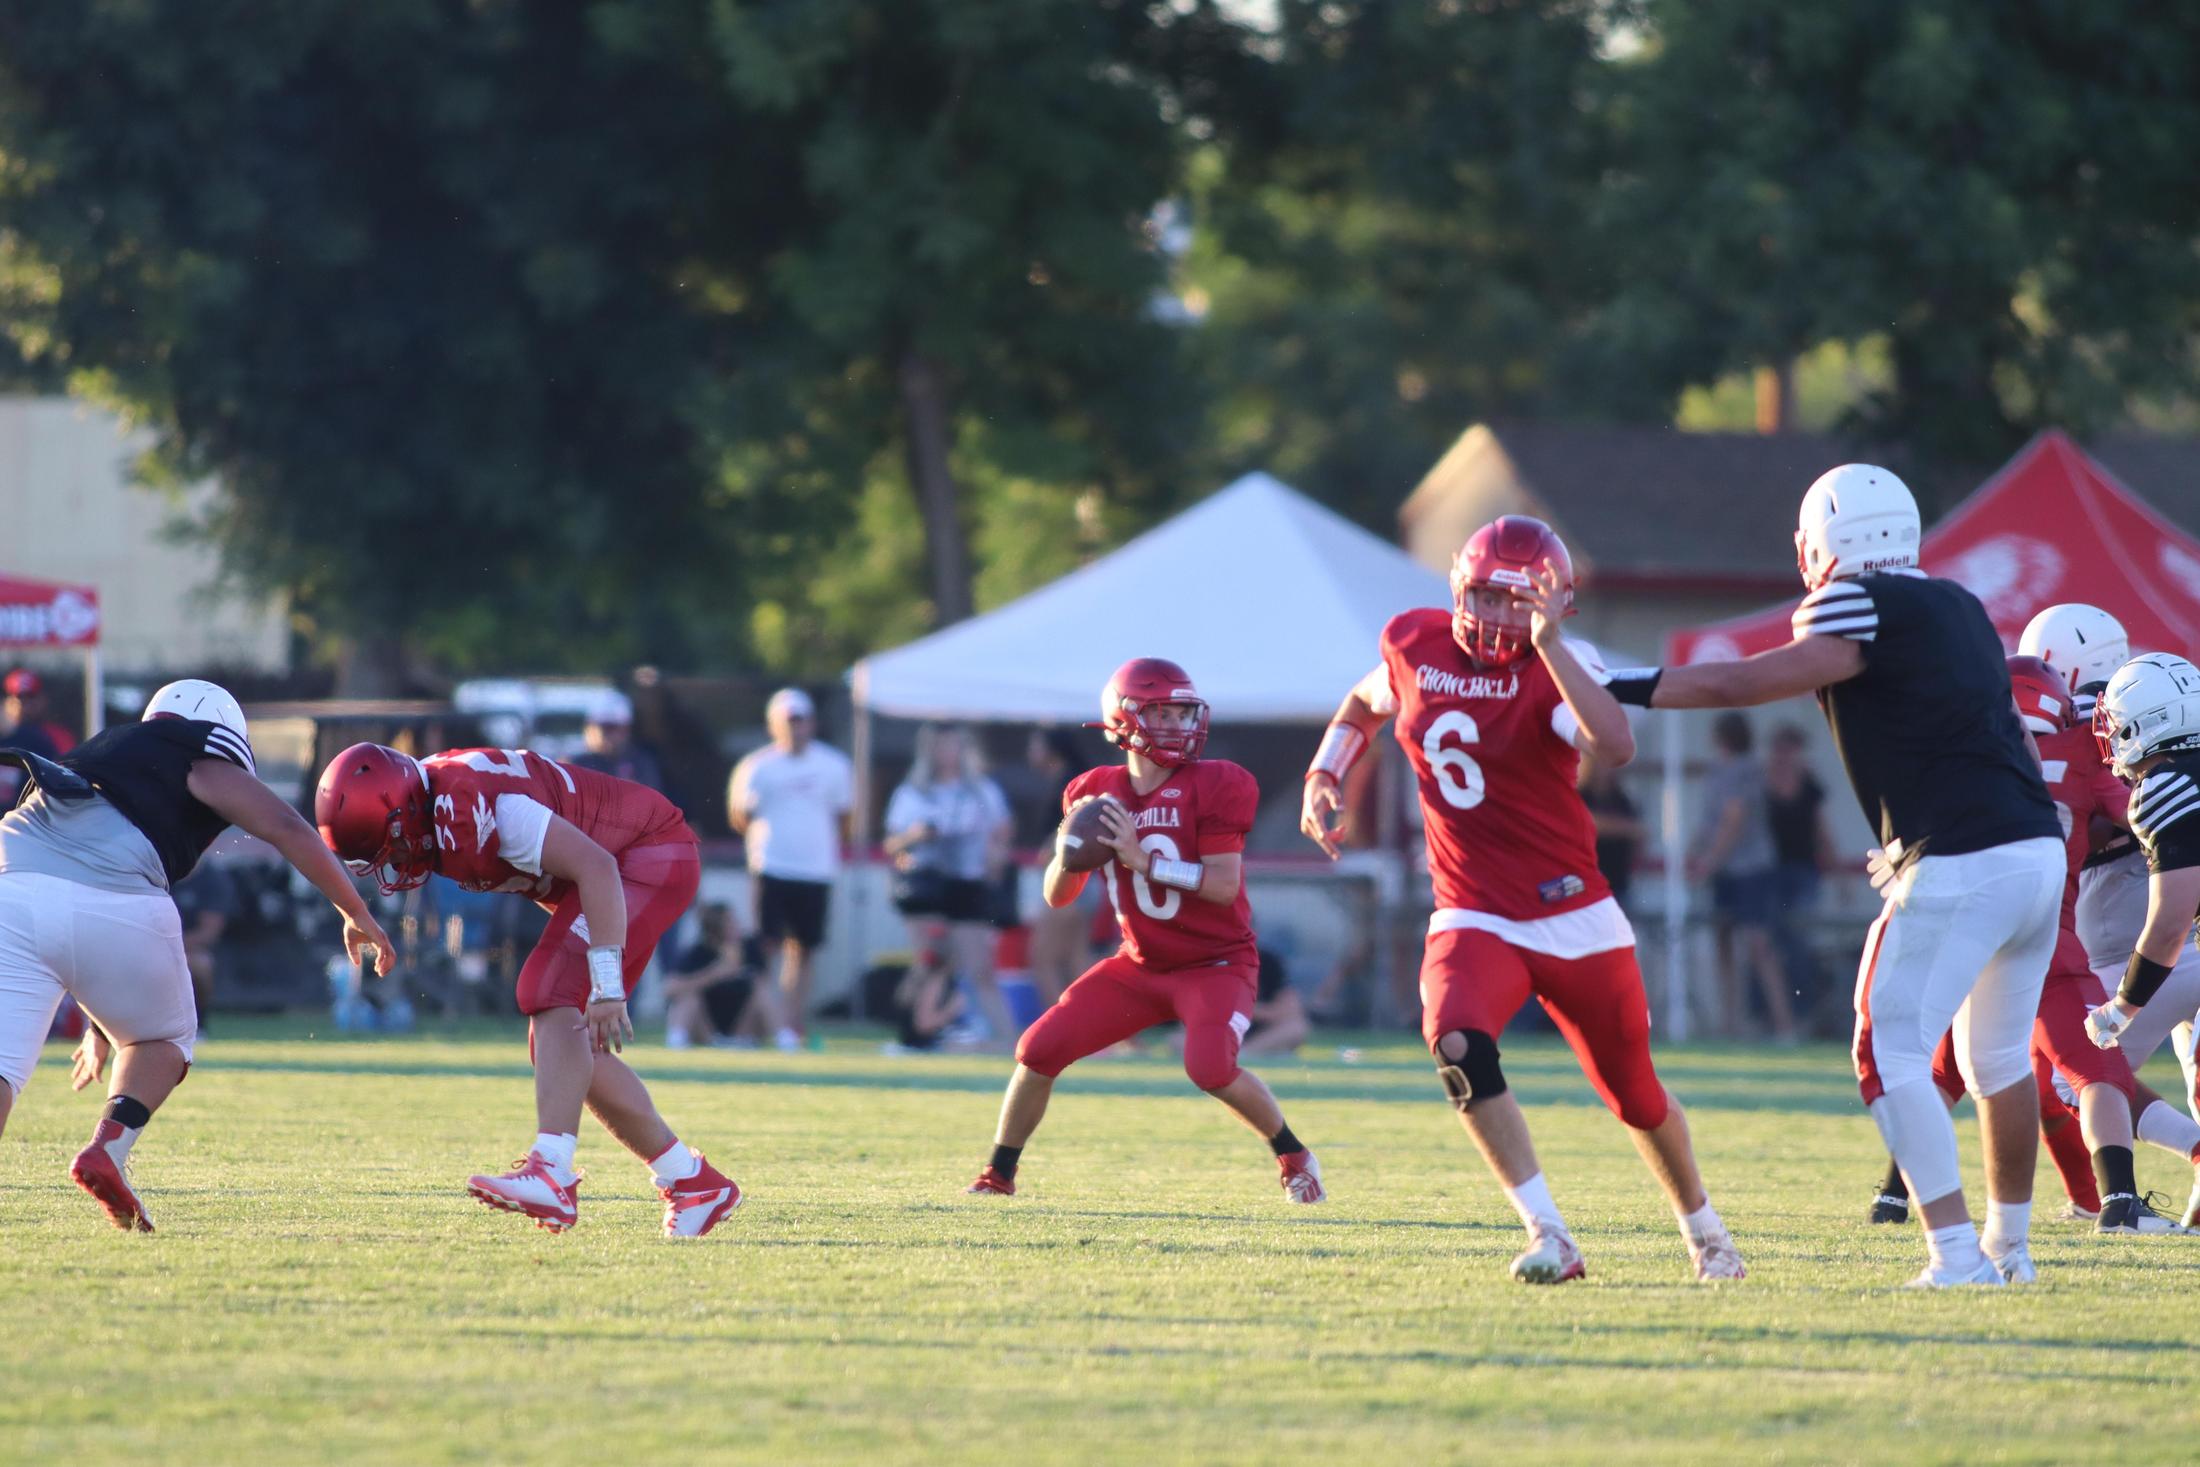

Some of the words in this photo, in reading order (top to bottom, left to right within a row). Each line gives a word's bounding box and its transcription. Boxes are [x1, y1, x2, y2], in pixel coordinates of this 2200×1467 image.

[1862, 555, 1910, 571] Riddell
[1422, 709, 1486, 811] 6
[433, 793, 457, 852] 53
[1128, 806, 1181, 829] CHILLA
